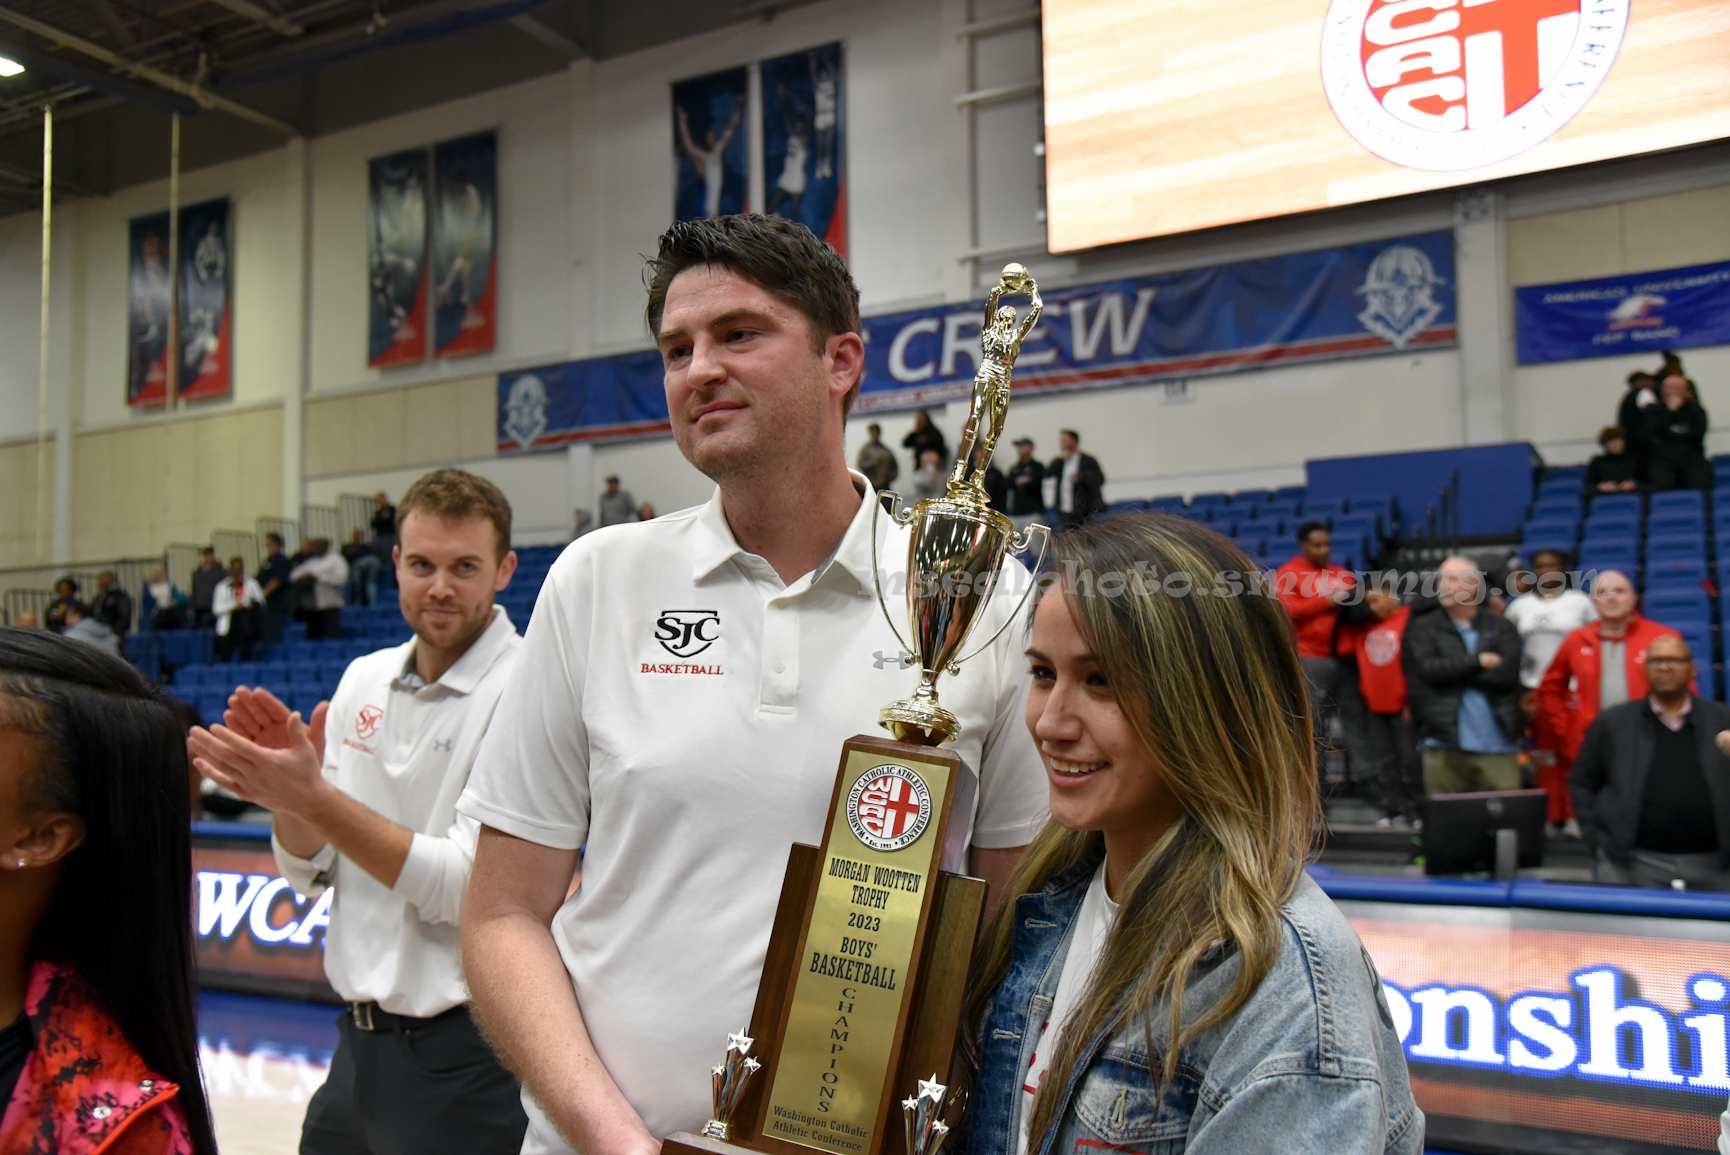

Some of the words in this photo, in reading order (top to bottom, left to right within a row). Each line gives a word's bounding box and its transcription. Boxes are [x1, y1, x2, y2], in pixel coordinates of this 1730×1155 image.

[888, 288, 1157, 383] CREW
[654, 617, 720, 650] SJC
[640, 663, 724, 675] BASKETBALL
[857, 766, 895, 788] CATHOLIC
[896, 768, 928, 798] ATHLETIC
[848, 787, 866, 839] WASHINGTON
[898, 799, 929, 845] CONFERENCE
[829, 857, 871, 883] MORGAN
[873, 866, 921, 893] WOOTTEN
[851, 885, 890, 910] TROPHY
[848, 912, 881, 932] 2023
[840, 937, 877, 959] BOYS'
[810, 952, 896, 990] BASKETBALL
[772, 1121, 809, 1138] Athletic
[811, 1131, 862, 1152] Conference
[774, 1105, 827, 1128] Washington
[830, 1120, 868, 1139] Catholic
